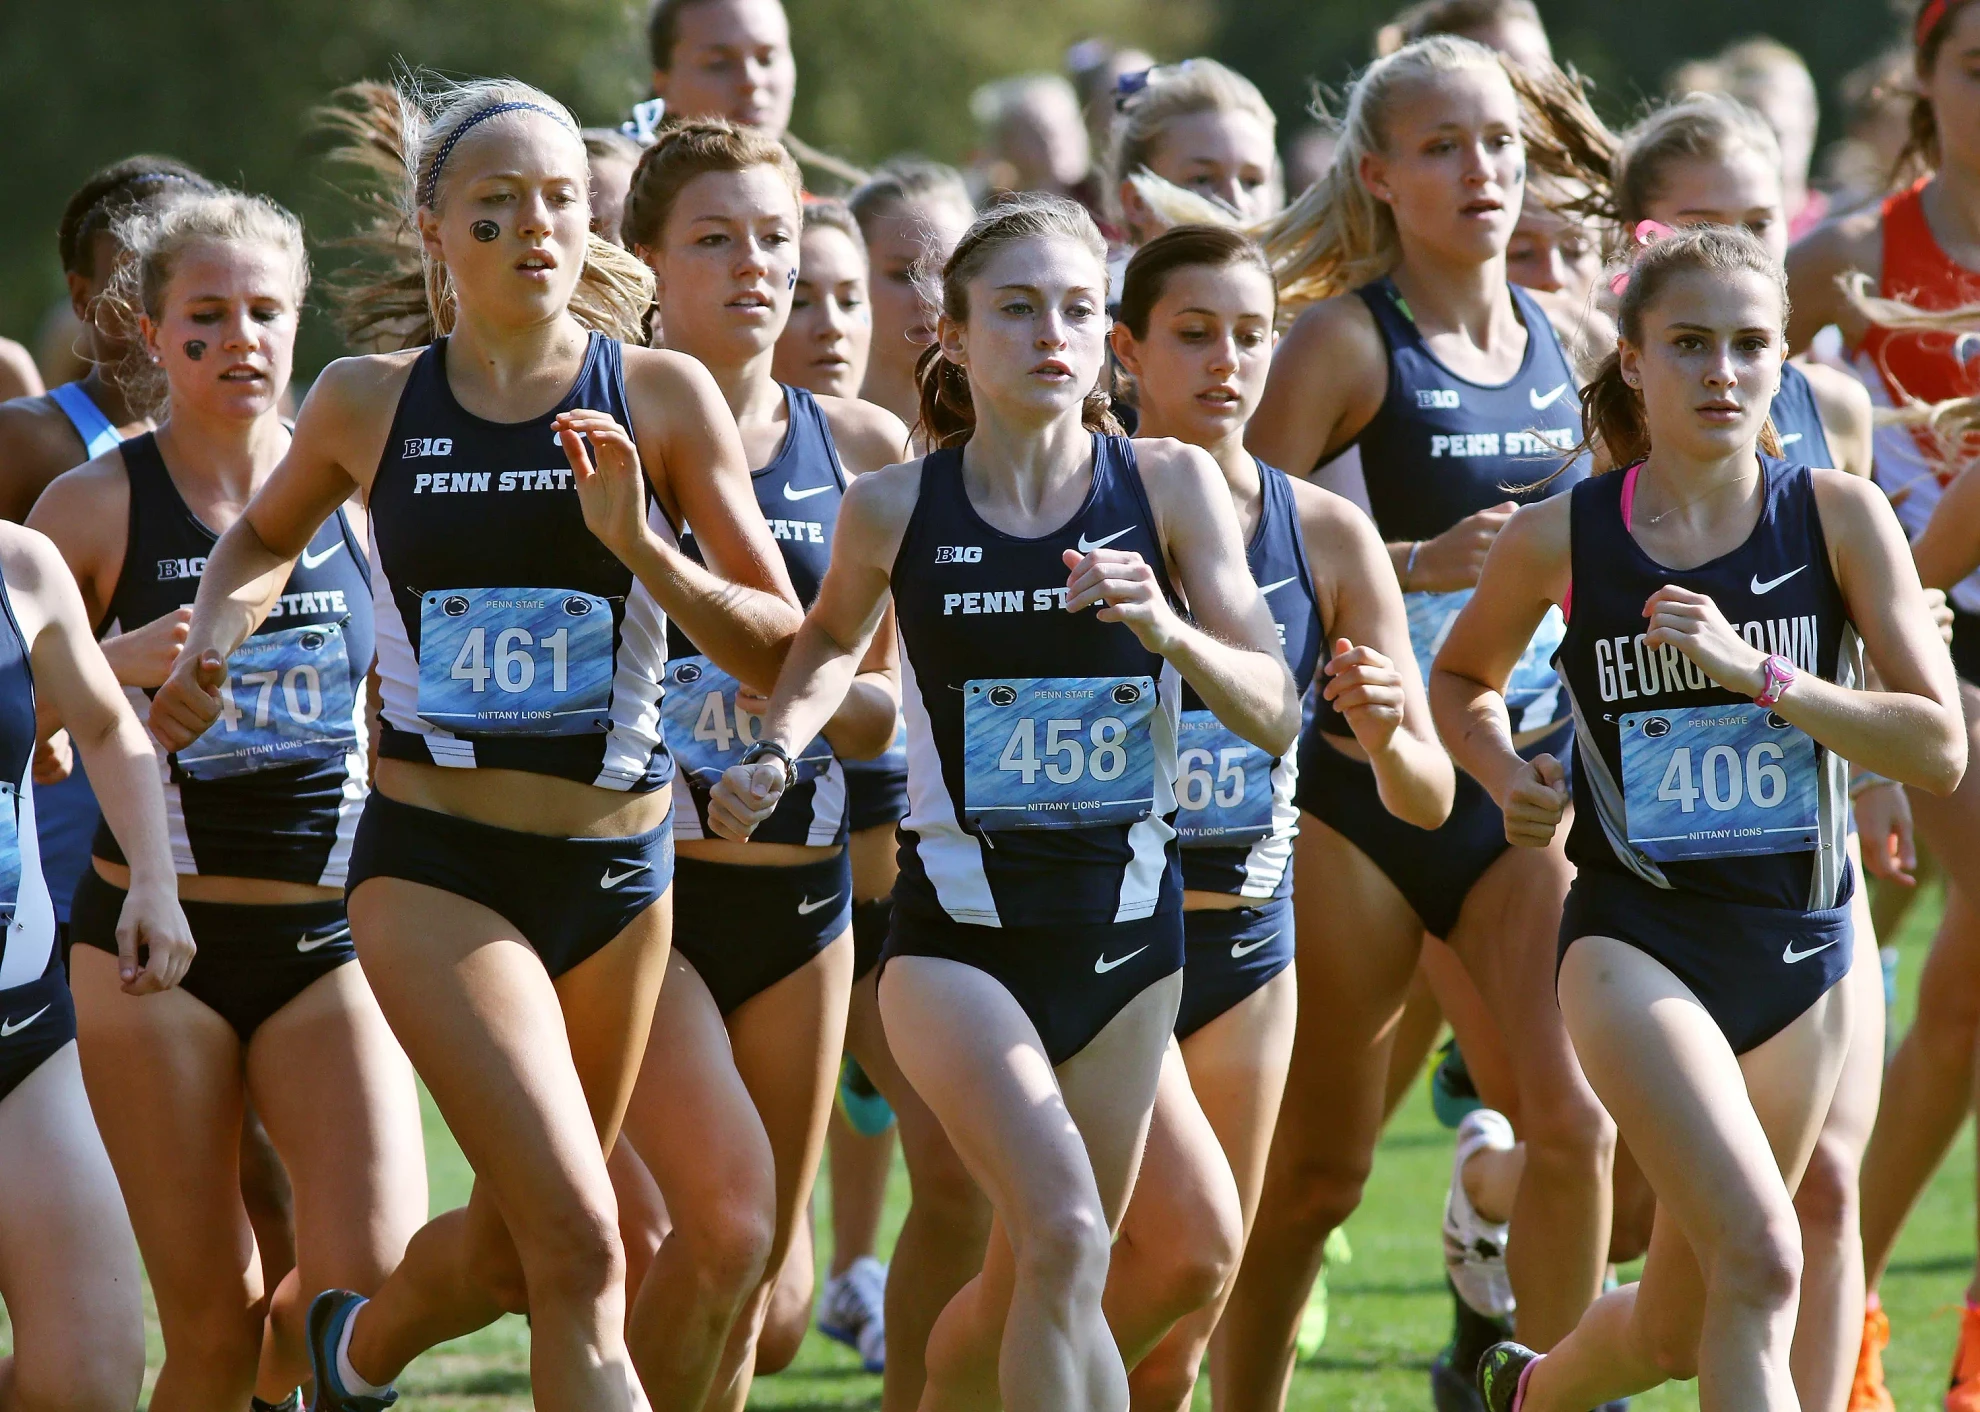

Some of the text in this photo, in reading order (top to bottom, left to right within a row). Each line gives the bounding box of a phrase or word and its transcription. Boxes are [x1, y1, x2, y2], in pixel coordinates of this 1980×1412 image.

[1431, 428, 1575, 457] PENN STATE
[413, 469, 578, 494] PENN STAT
[485, 600, 545, 609] PENN STATE
[943, 590, 1025, 616] PENN
[450, 627, 569, 693] 461
[218, 664, 323, 732] 470
[1034, 690, 1094, 699] PENN STATE
[477, 710, 552, 720] NITTANY LIONS
[694, 690, 768, 751] 46
[1688, 716, 1748, 728] PENN STATE
[236, 739, 303, 758] NITTANY LIONS
[999, 716, 1128, 785] 458
[1174, 746, 1248, 811] 65
[1657, 741, 1787, 813] 406
[1027, 800, 1101, 812] NITTANY LIONS
[1198, 826, 1225, 837] LIONS
[1689, 827, 1763, 841] NITTANY LIONS
